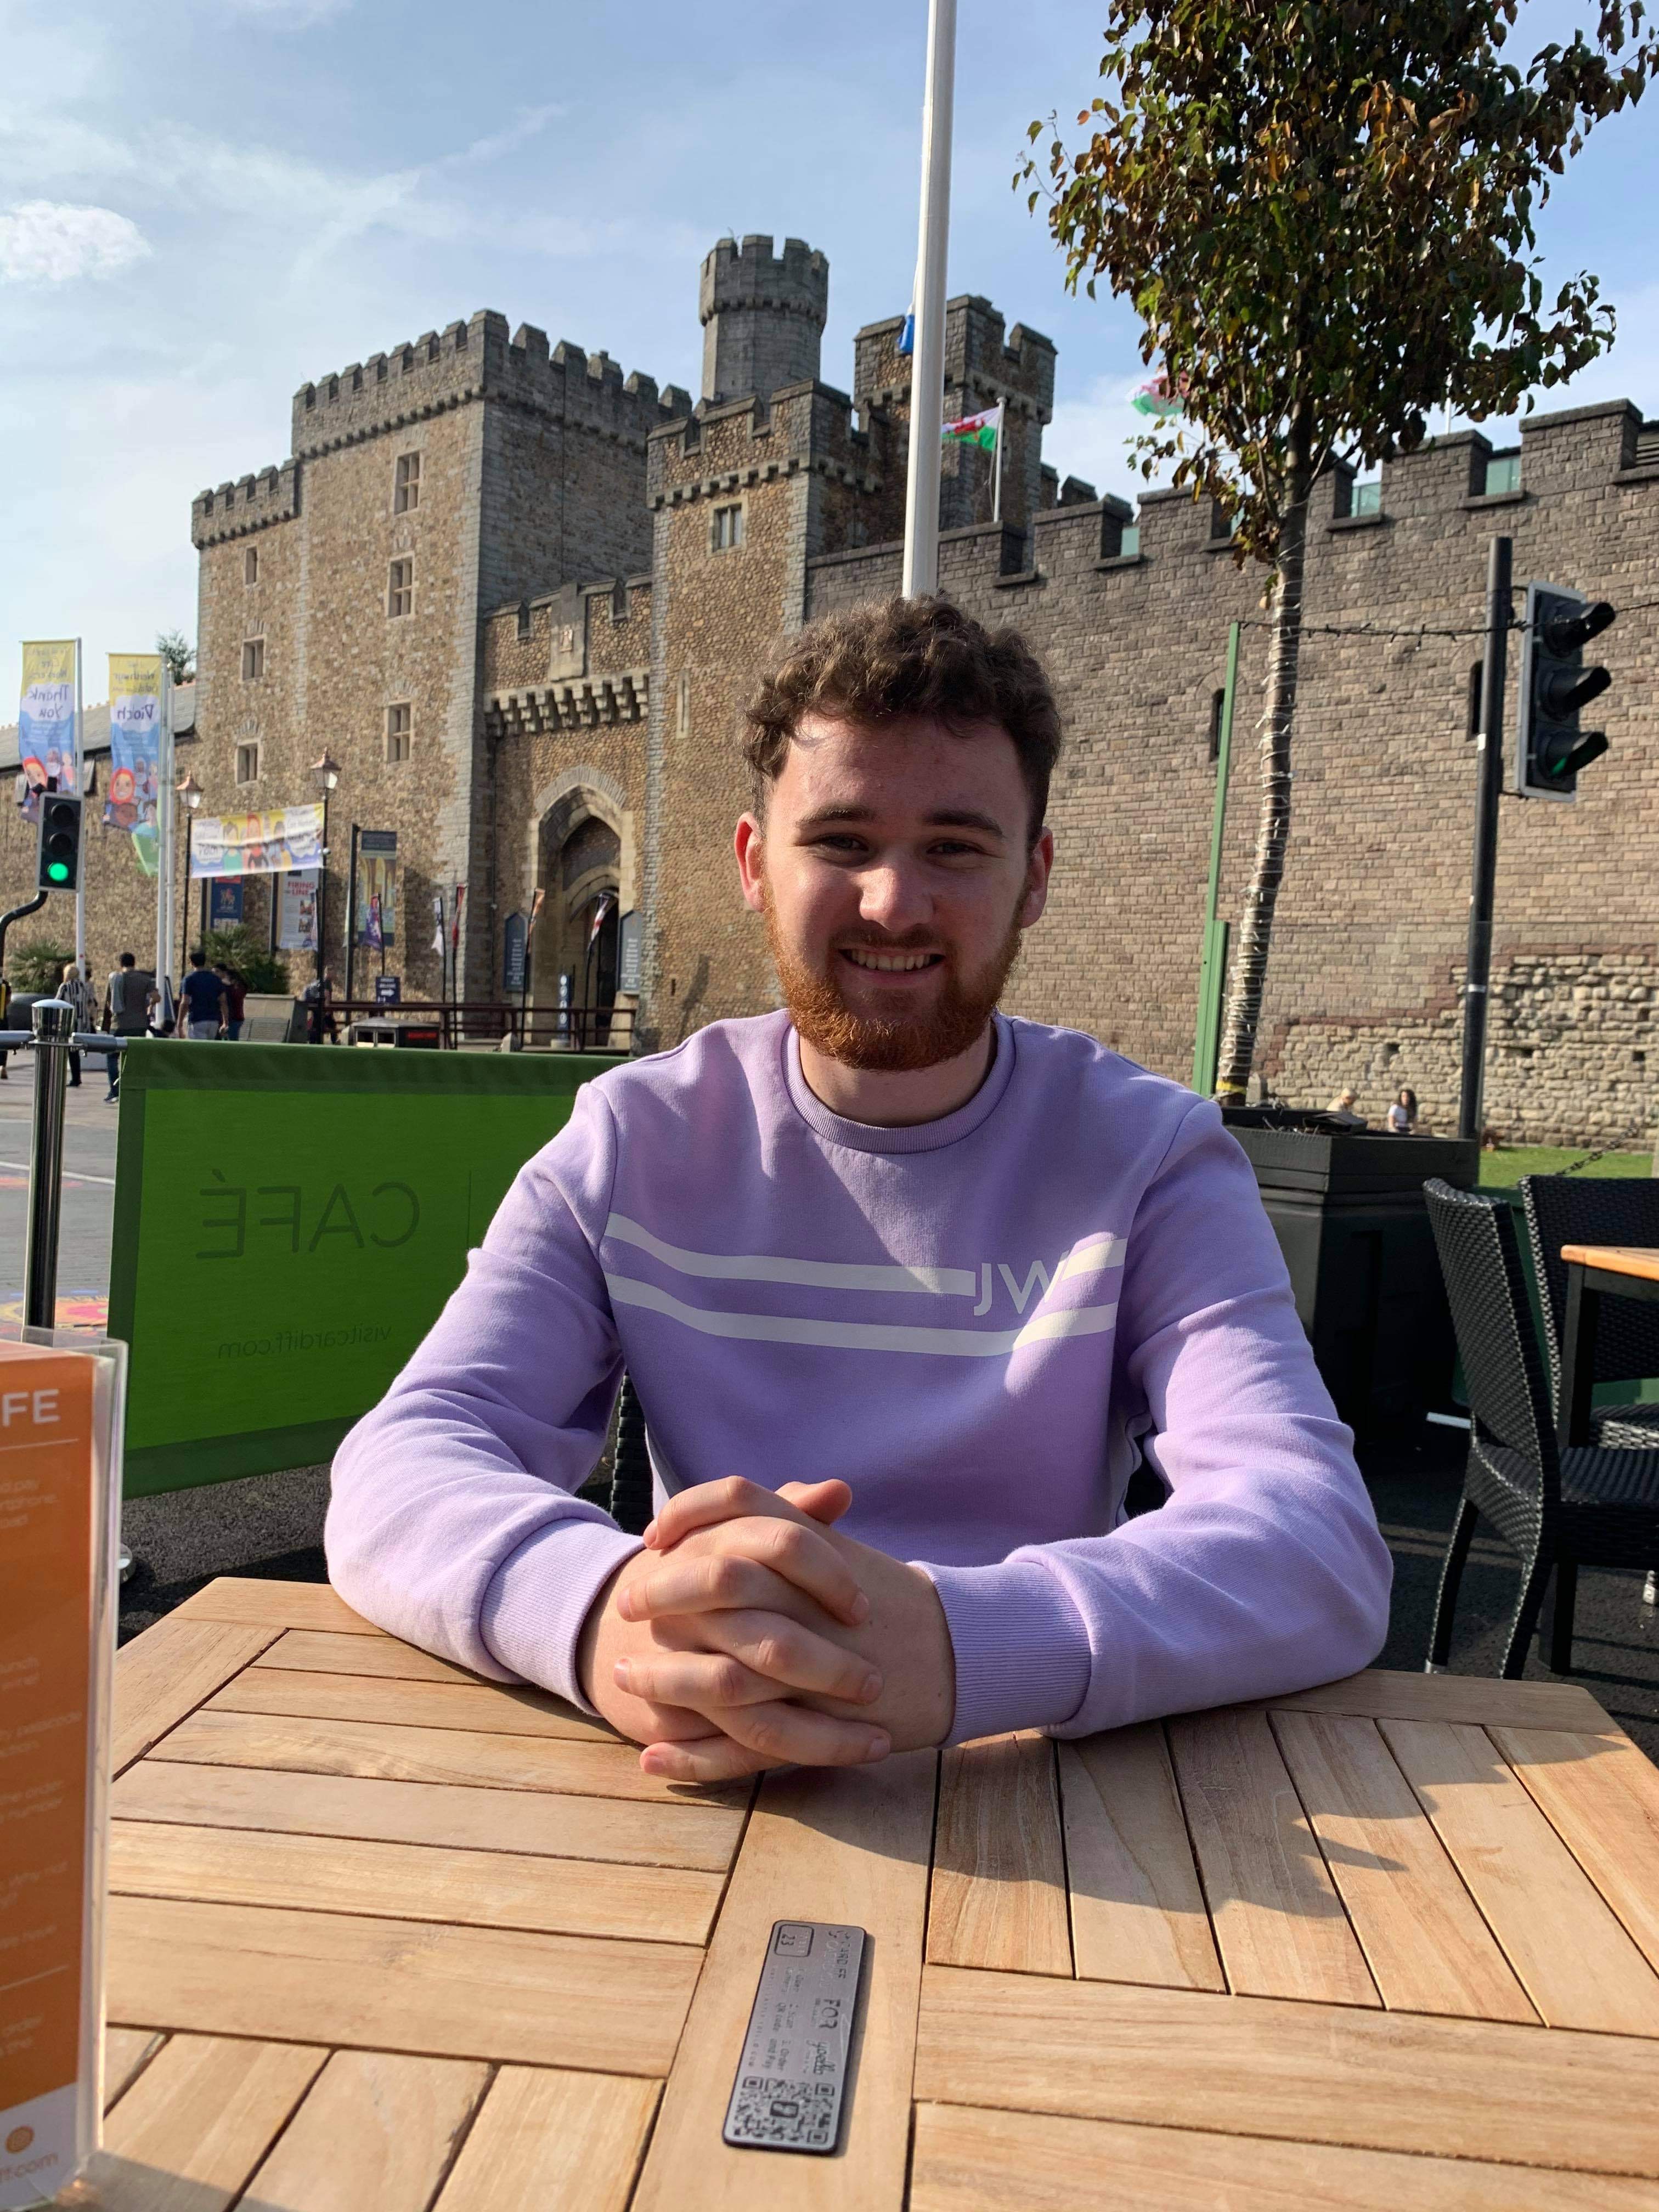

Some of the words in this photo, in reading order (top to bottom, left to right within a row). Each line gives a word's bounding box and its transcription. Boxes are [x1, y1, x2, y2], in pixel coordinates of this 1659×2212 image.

[973, 1251, 1070, 1317] JW
[780, 1933, 795, 1945] 23
[820, 1998, 840, 2029] FOR
